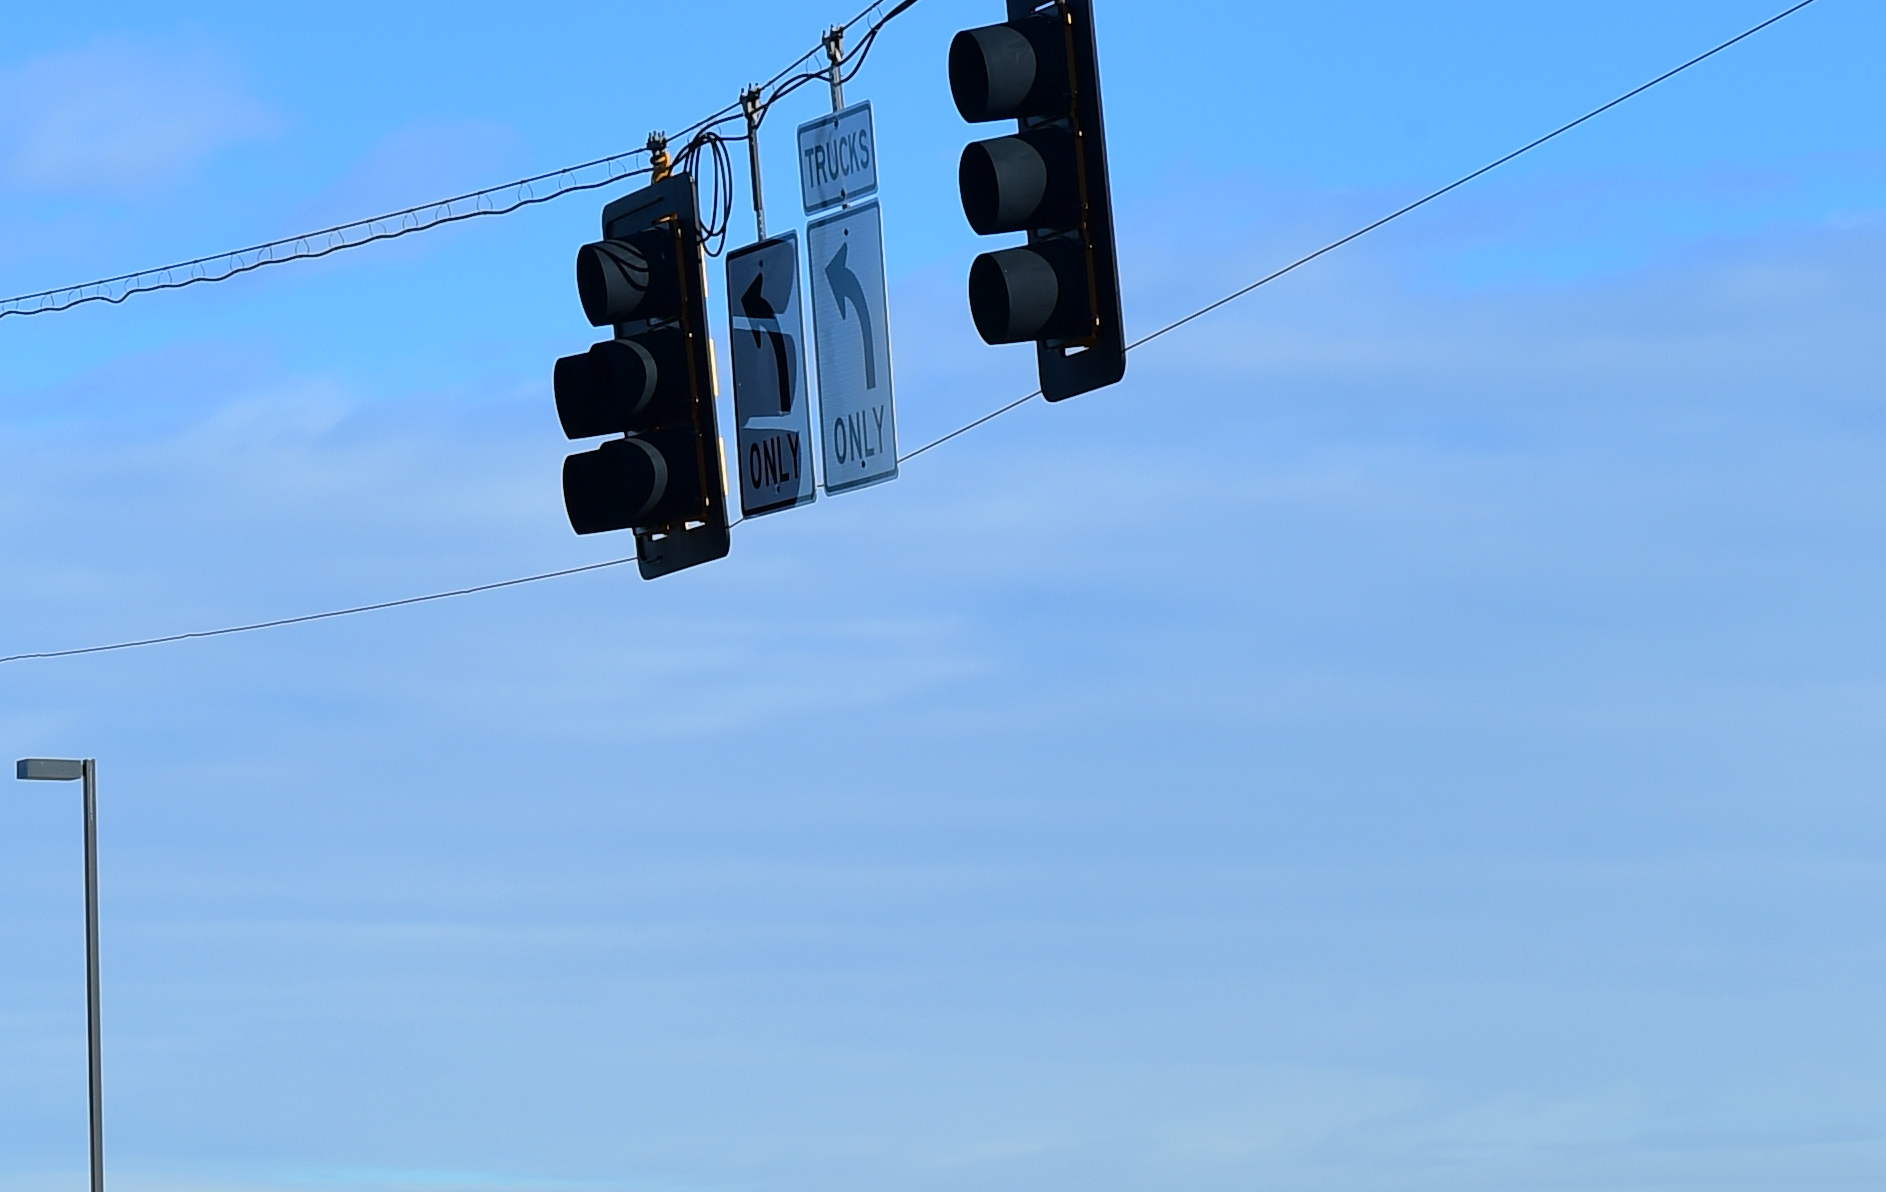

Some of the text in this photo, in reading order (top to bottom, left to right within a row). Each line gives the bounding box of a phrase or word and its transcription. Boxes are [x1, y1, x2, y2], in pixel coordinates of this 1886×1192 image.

[804, 129, 870, 188] TRUCKS
[750, 432, 800, 489] ONLY
[834, 405, 884, 464] ONLY
